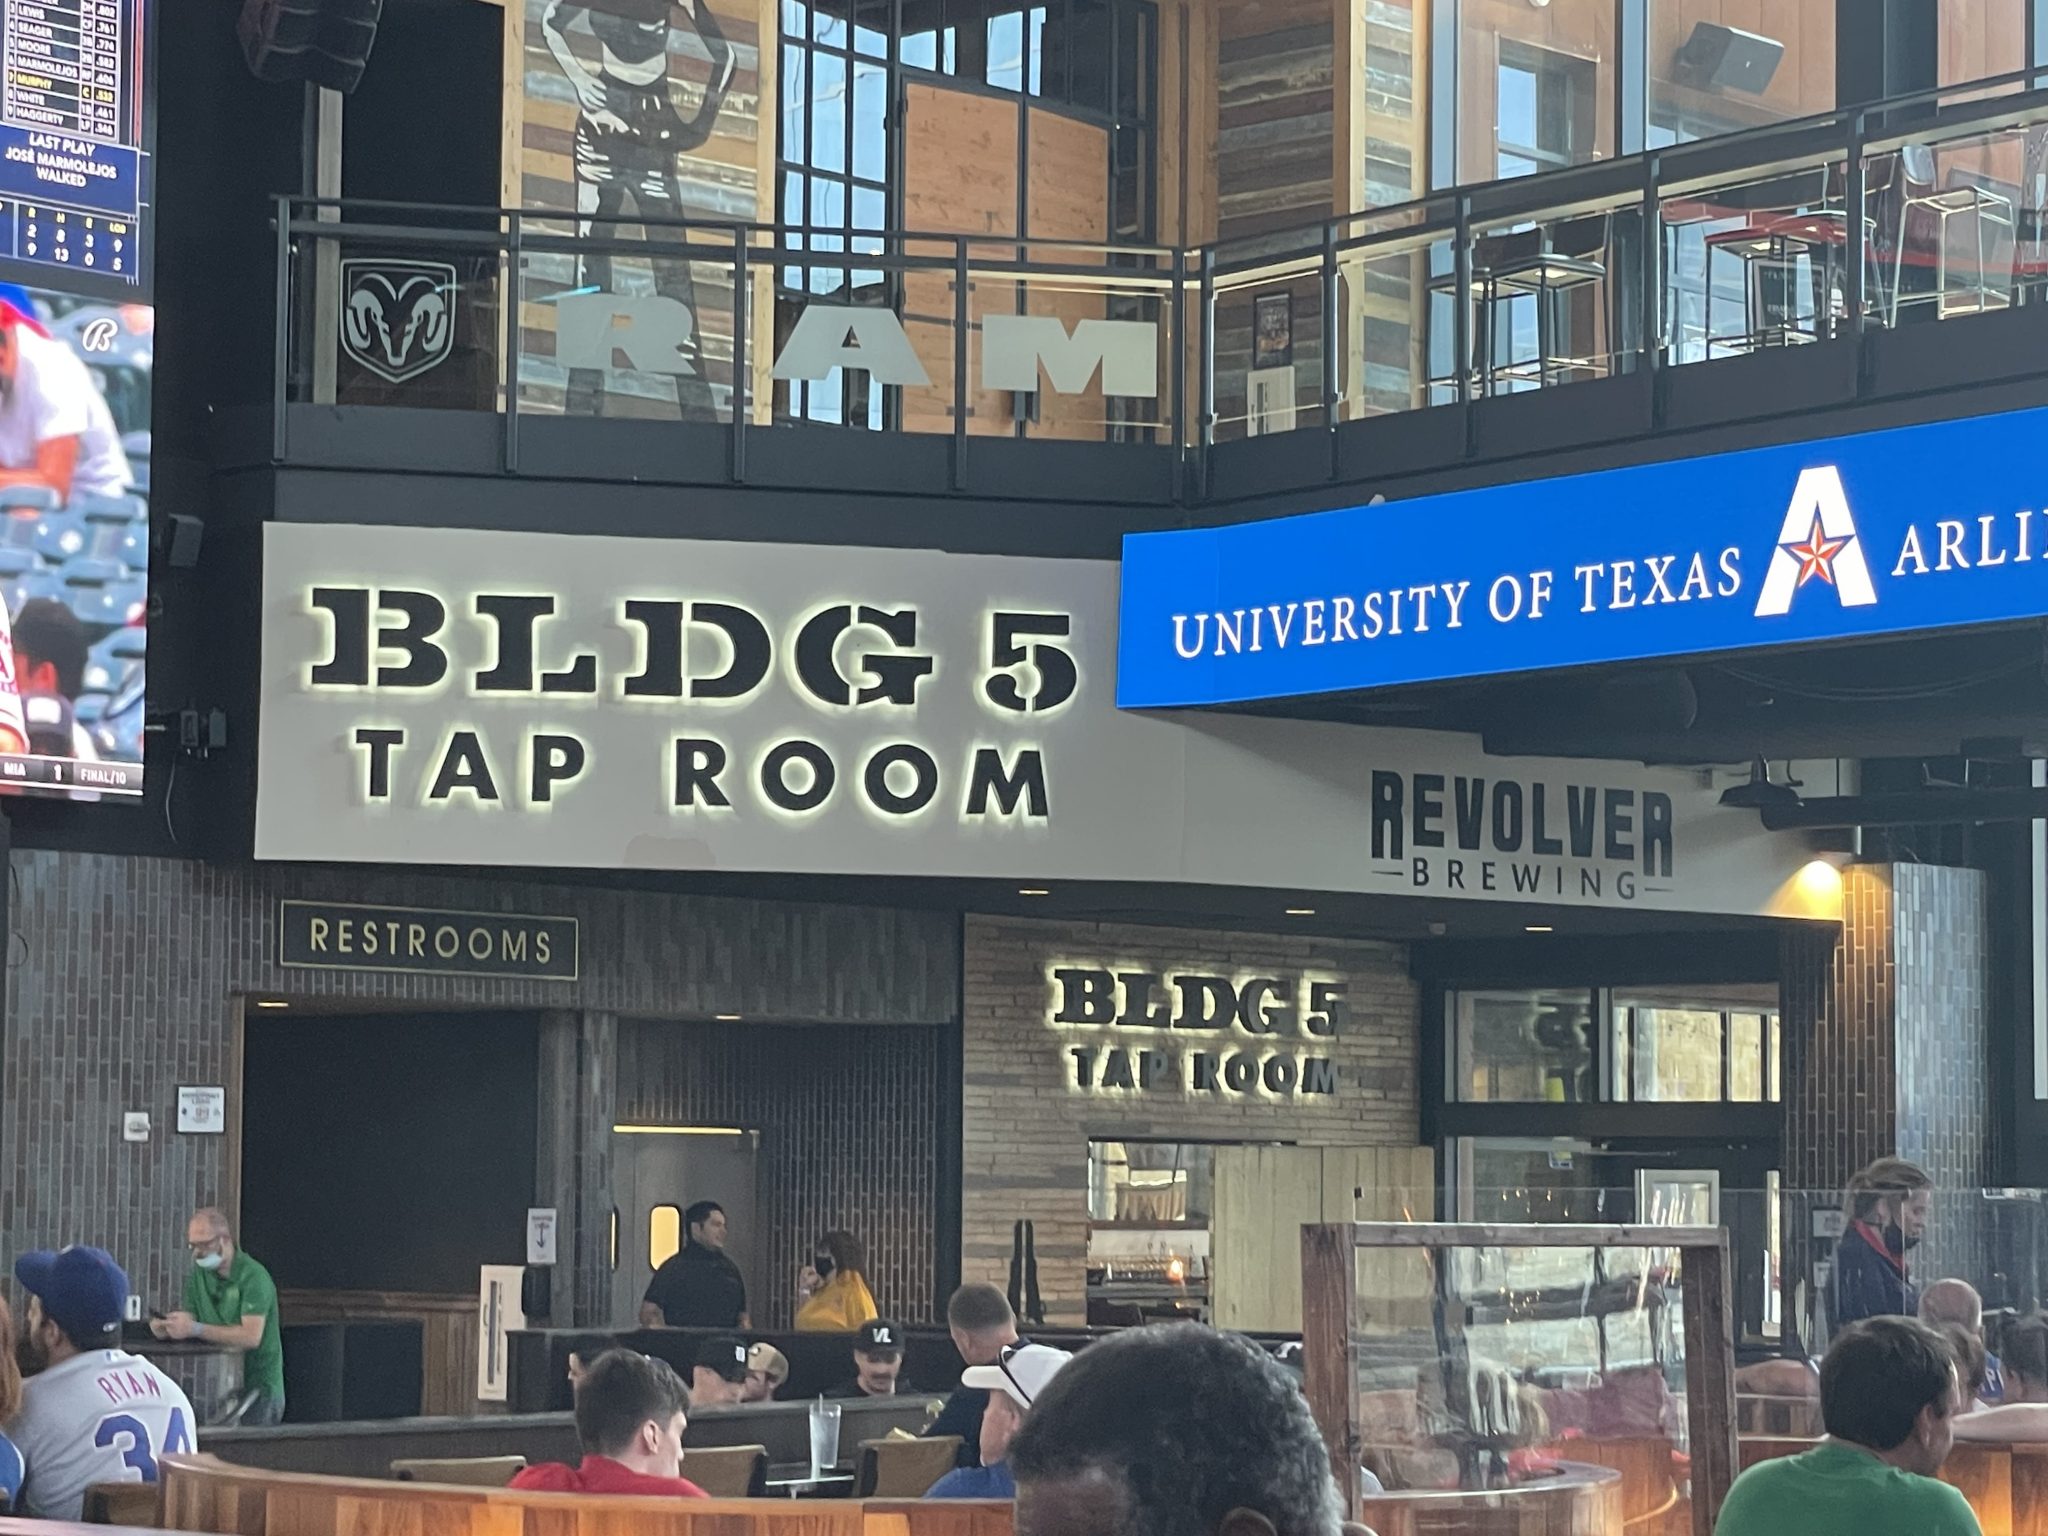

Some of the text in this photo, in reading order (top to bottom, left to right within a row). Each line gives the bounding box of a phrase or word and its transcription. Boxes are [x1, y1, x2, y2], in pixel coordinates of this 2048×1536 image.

[18, 4, 45, 19] LEWIS
[18, 22, 53, 38] SEAGER
[18, 38, 51, 55] MOORE
[18, 55, 78, 78] MARMOLEJOS
[16, 90, 45, 106] WHITE
[17, 73, 52, 90] MURPHY
[82, 87, 90, 98] C
[16, 106, 64, 126] HAGGERTY
[28, 132, 96, 157] LAST PLAY
[5, 147, 117, 179] JOSÉ MARMOLEJOS
[36, 167, 87, 188] WALKED
[56, 212, 66, 224] H
[27, 223, 123, 253] 2 8 3 9
[27, 242, 122, 271] 9 13 0 5
[556, 295, 1157, 398] RAM
[1172, 581, 1470, 659] UNIVERSITY
[1488, 570, 1553, 623] OF
[1574, 546, 1743, 613] TEXAS
[1890, 507, 2048, 577] ARLI
[310, 587, 1079, 712] BLDG 5
[4, 762, 127, 785] MIA 1 FINAL/10
[355, 729, 1049, 818] TAP ROOM
[1371, 769, 1673, 877] REVOLVER
[1412, 857, 1635, 900] BREWING
[310, 917, 551, 964] RESTROOMS
[1053, 968, 1349, 1036] BLDG 5
[1071, 1047, 1339, 1094] TAP ROOM
[97, 1370, 161, 1404] RYAN
[94, 1406, 192, 1482] 34
